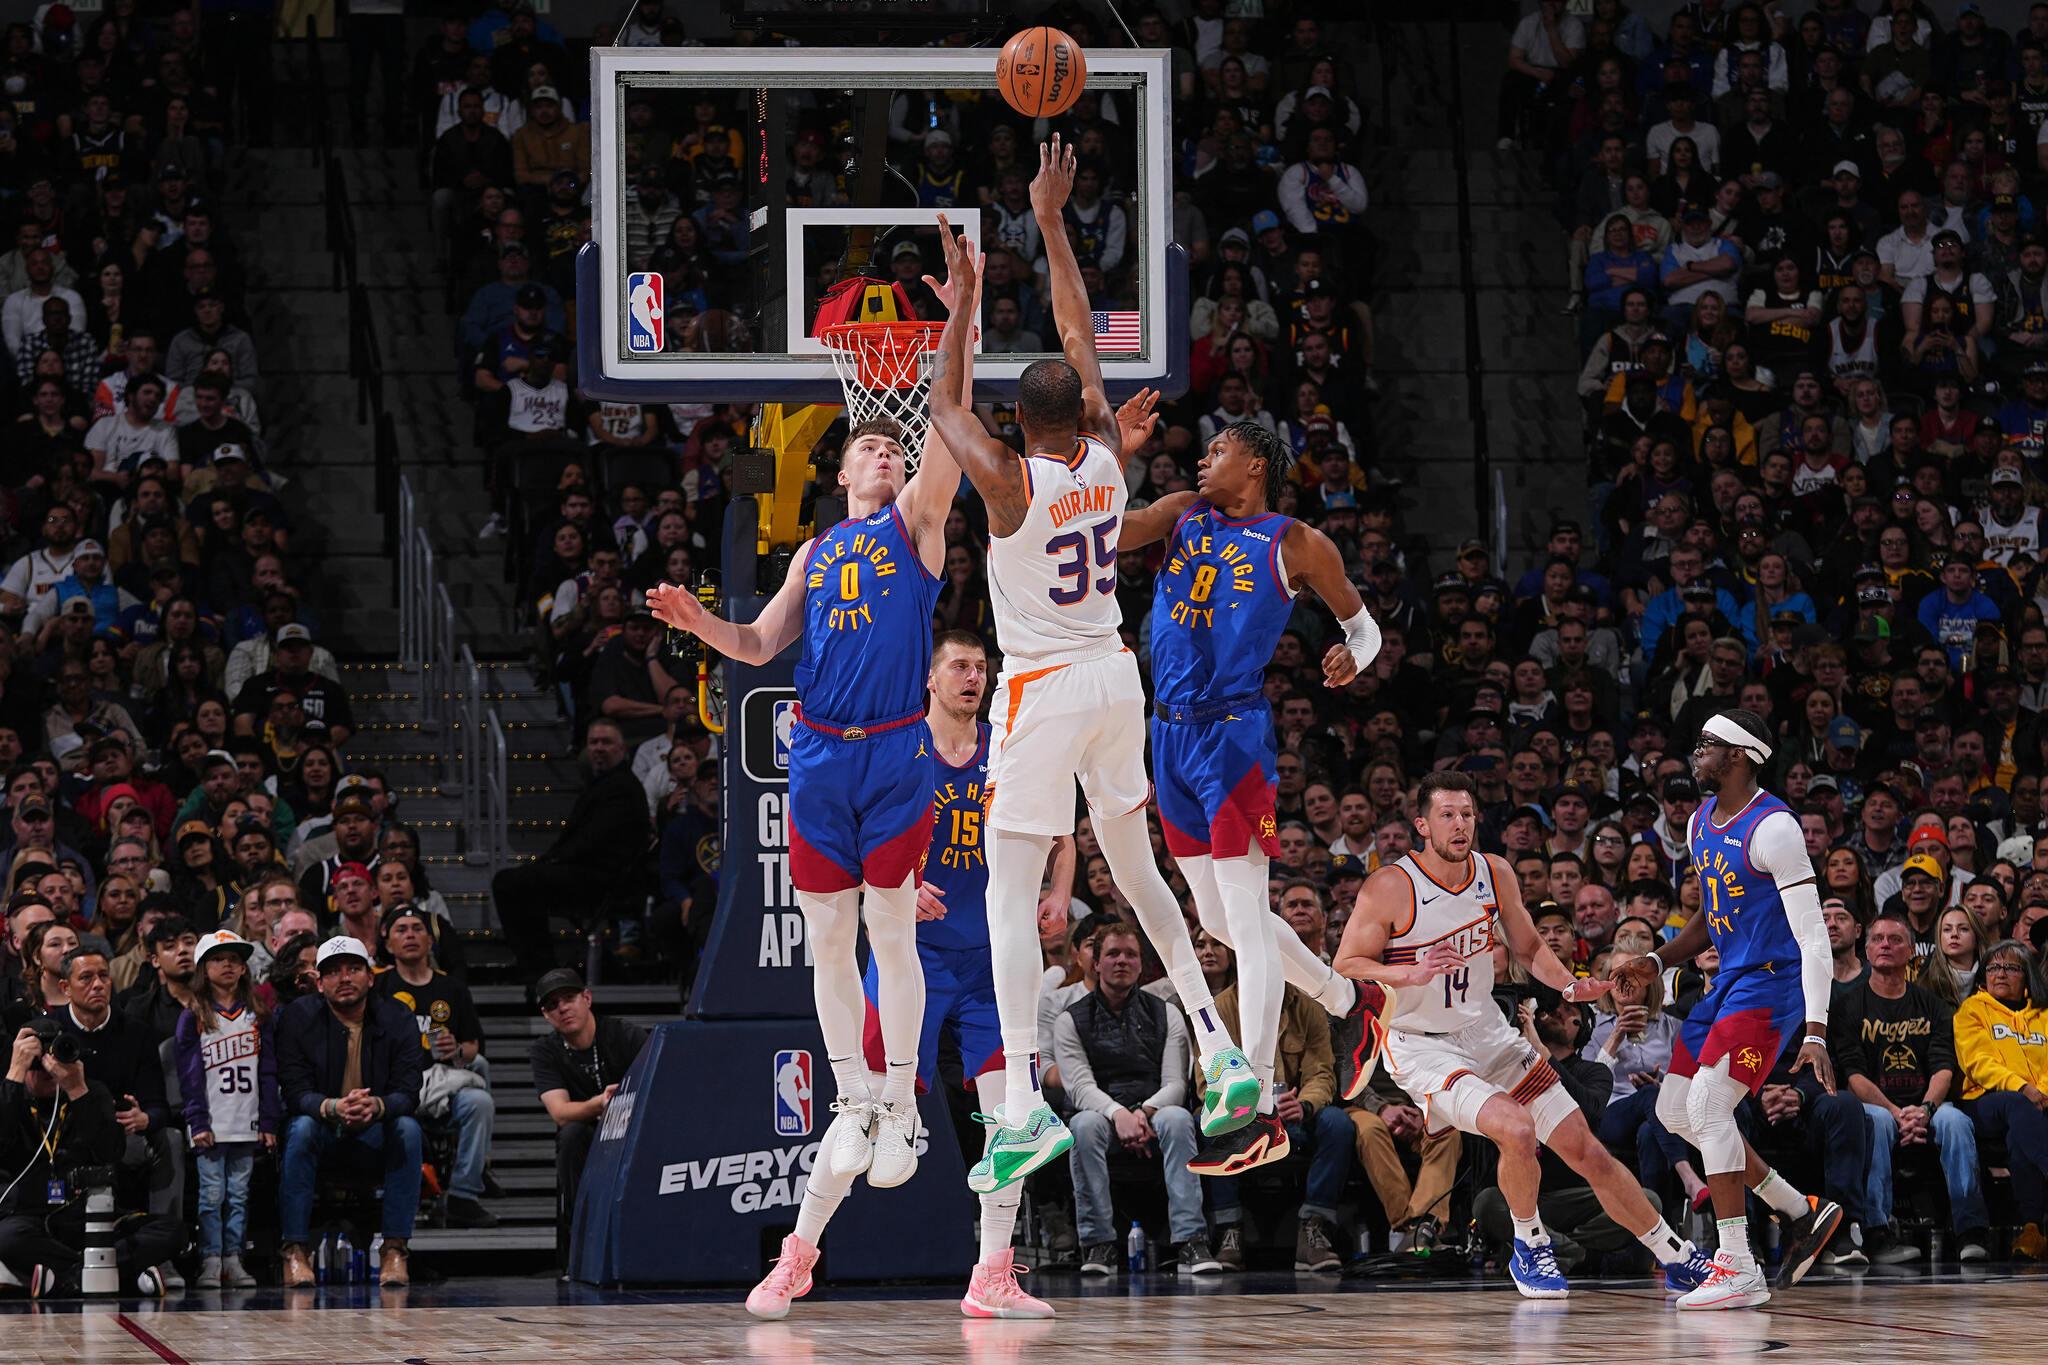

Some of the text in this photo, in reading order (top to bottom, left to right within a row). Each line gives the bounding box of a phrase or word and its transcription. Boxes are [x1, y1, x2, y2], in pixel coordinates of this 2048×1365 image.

[1047, 44, 1069, 102] Wilson
[633, 335, 650, 347] NBA
[866, 512, 891, 526] ibotta
[1048, 485, 1115, 529] DURANT
[1242, 528, 1271, 543] ibotta
[808, 533, 897, 588] MILE HIGH
[1045, 514, 1118, 607] 35
[1168, 535, 1254, 592] MILE HIGH
[841, 562, 860, 601] 0
[1189, 564, 1218, 604] 8
[828, 603, 872, 630] CITY
[1170, 600, 1214, 630] CITY
[951, 809, 980, 847] 15
[1723, 835, 1742, 848] ibotta
[940, 847, 985, 870] CITY
[1714, 851, 1745, 898] HIGH
[1475, 893, 1491, 901] PayPal
[1707, 876, 1719, 912] 7
[1708, 911, 1734, 936] CTY
[1444, 965, 1469, 1008] 14
[1861, 1016, 1931, 1045] Nuggets
[219, 1066, 252, 1093] 35
[780, 1116, 799, 1131] NBA
